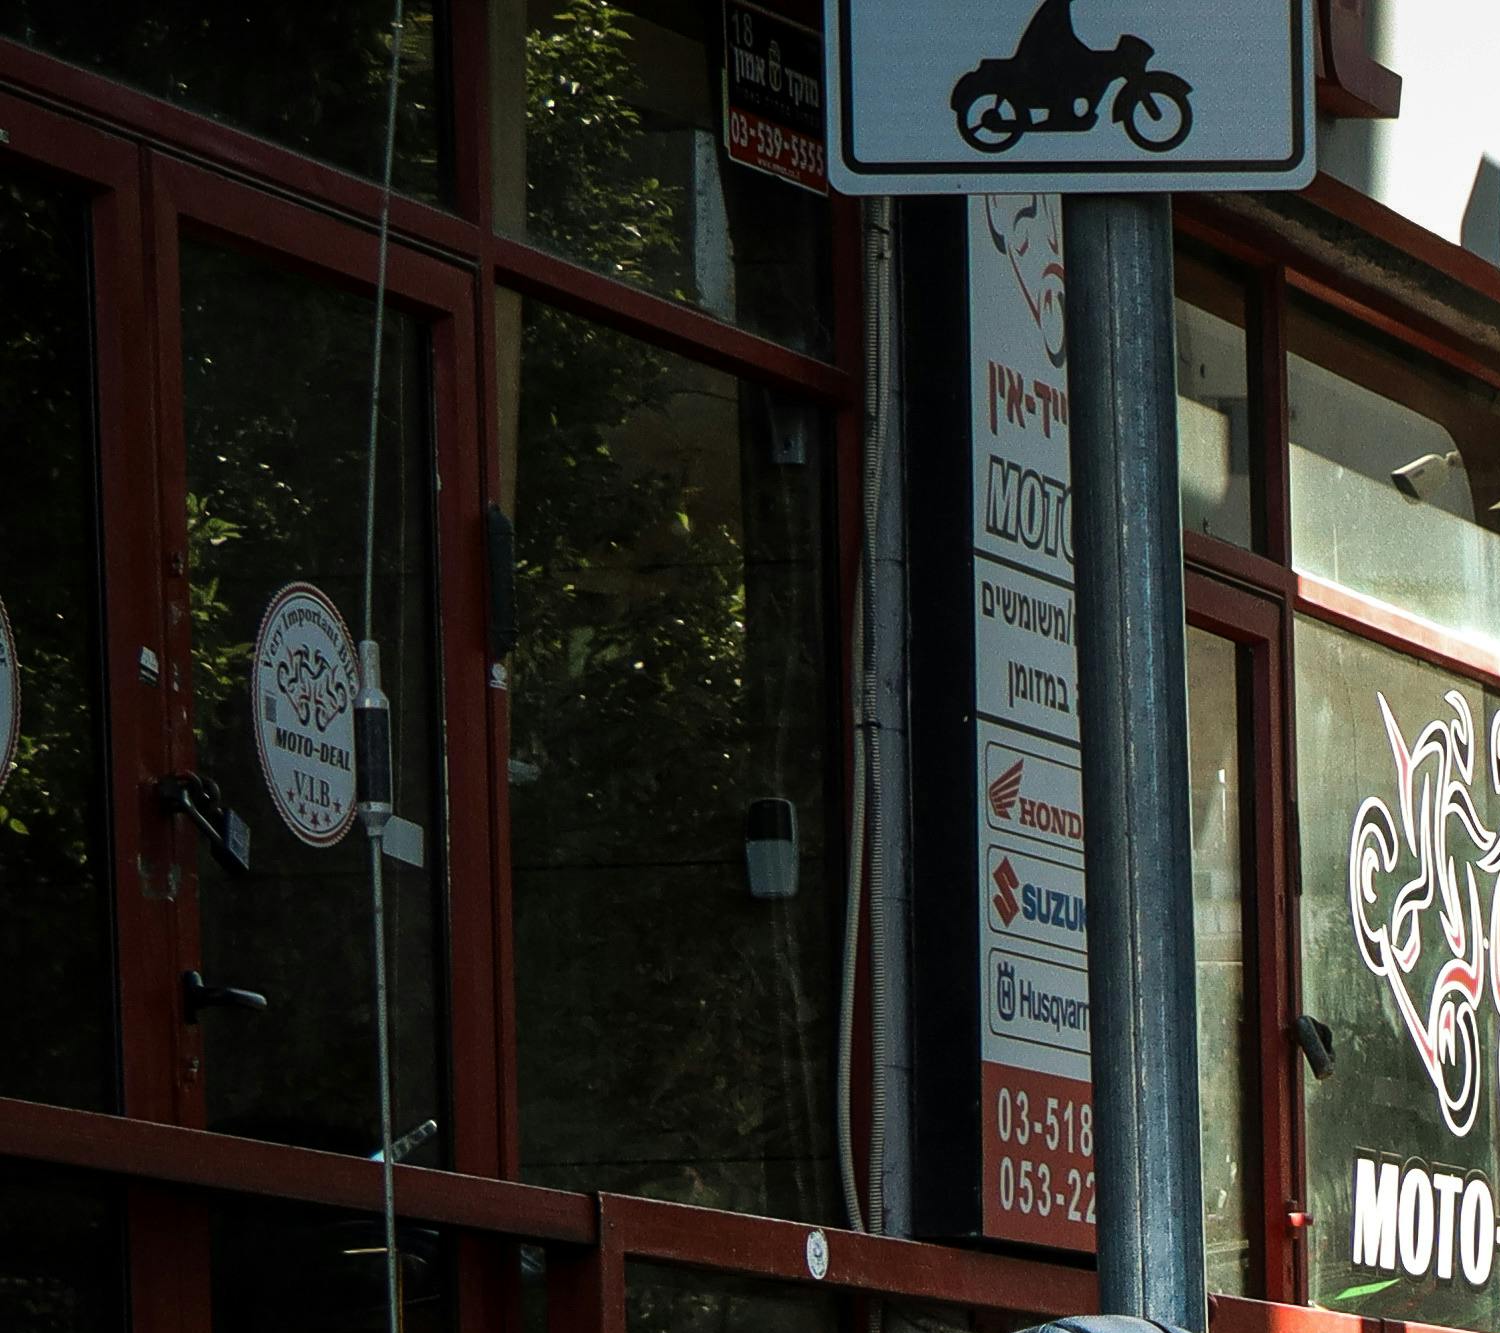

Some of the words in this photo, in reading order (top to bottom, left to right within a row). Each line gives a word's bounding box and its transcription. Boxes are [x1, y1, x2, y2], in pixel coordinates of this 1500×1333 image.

[730, 110, 824, 176] 03-539-5555
[282, 606, 339, 643] Important
[261, 628, 284, 670] Very
[1008, 660, 1070, 713] במזומן
[275, 727, 351, 772] MOTO-DEAL
[1018, 796, 1084, 842] HOND
